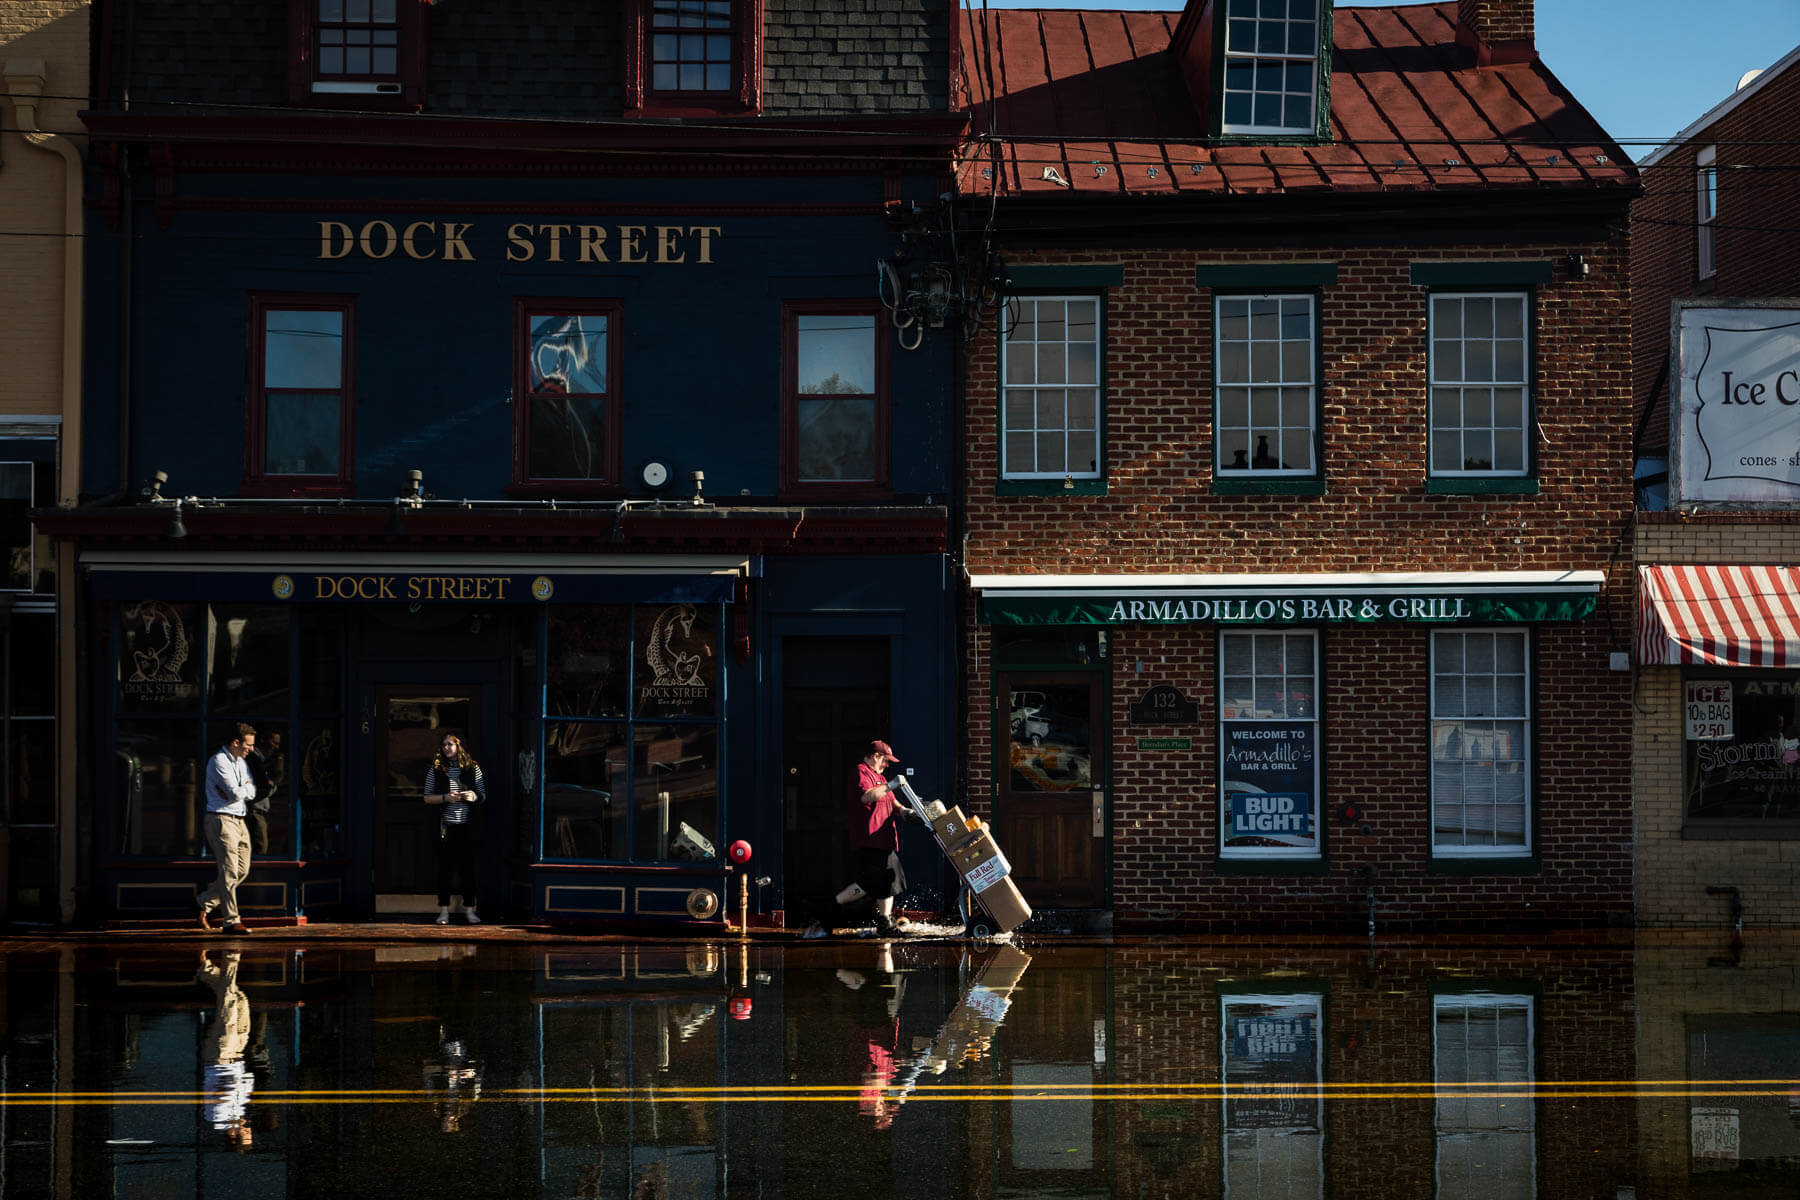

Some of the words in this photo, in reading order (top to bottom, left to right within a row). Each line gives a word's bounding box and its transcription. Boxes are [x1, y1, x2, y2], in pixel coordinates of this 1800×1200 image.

[316, 220, 477, 262] DOCK
[506, 223, 722, 265] STREET
[1721, 371, 1766, 406] Ice
[1775, 369, 1800, 406] C
[1739, 456, 1777, 467] cones
[314, 576, 398, 599] DOCK
[407, 576, 511, 600] STREET
[1109, 599, 1296, 621] ARMADILLO'S
[1301, 599, 1353, 620] BAR
[1360, 599, 1384, 619] &
[1388, 598, 1472, 619] GRILL
[642, 687, 671, 698] DOCK
[672, 687, 709, 698] STREET
[1153, 692, 1176, 708] 132
[1687, 685, 1730, 703] ICE
[1708, 704, 1731, 721] BAG
[1232, 730, 1288, 740] WELCOME
[1290, 730, 1306, 740] TO
[1226, 742, 1312, 763] Armadillo's
[1697, 740, 1778, 772] Storm
[1240, 763, 1260, 771] BAR
[1261, 763, 1269, 771] &
[1271, 762, 1298, 771] GRILL
[1245, 797, 1295, 815] BUD
[1236, 814, 1304, 831] LIGHT
[968, 868, 982, 881] Full
[980, 861, 994, 874] Red
